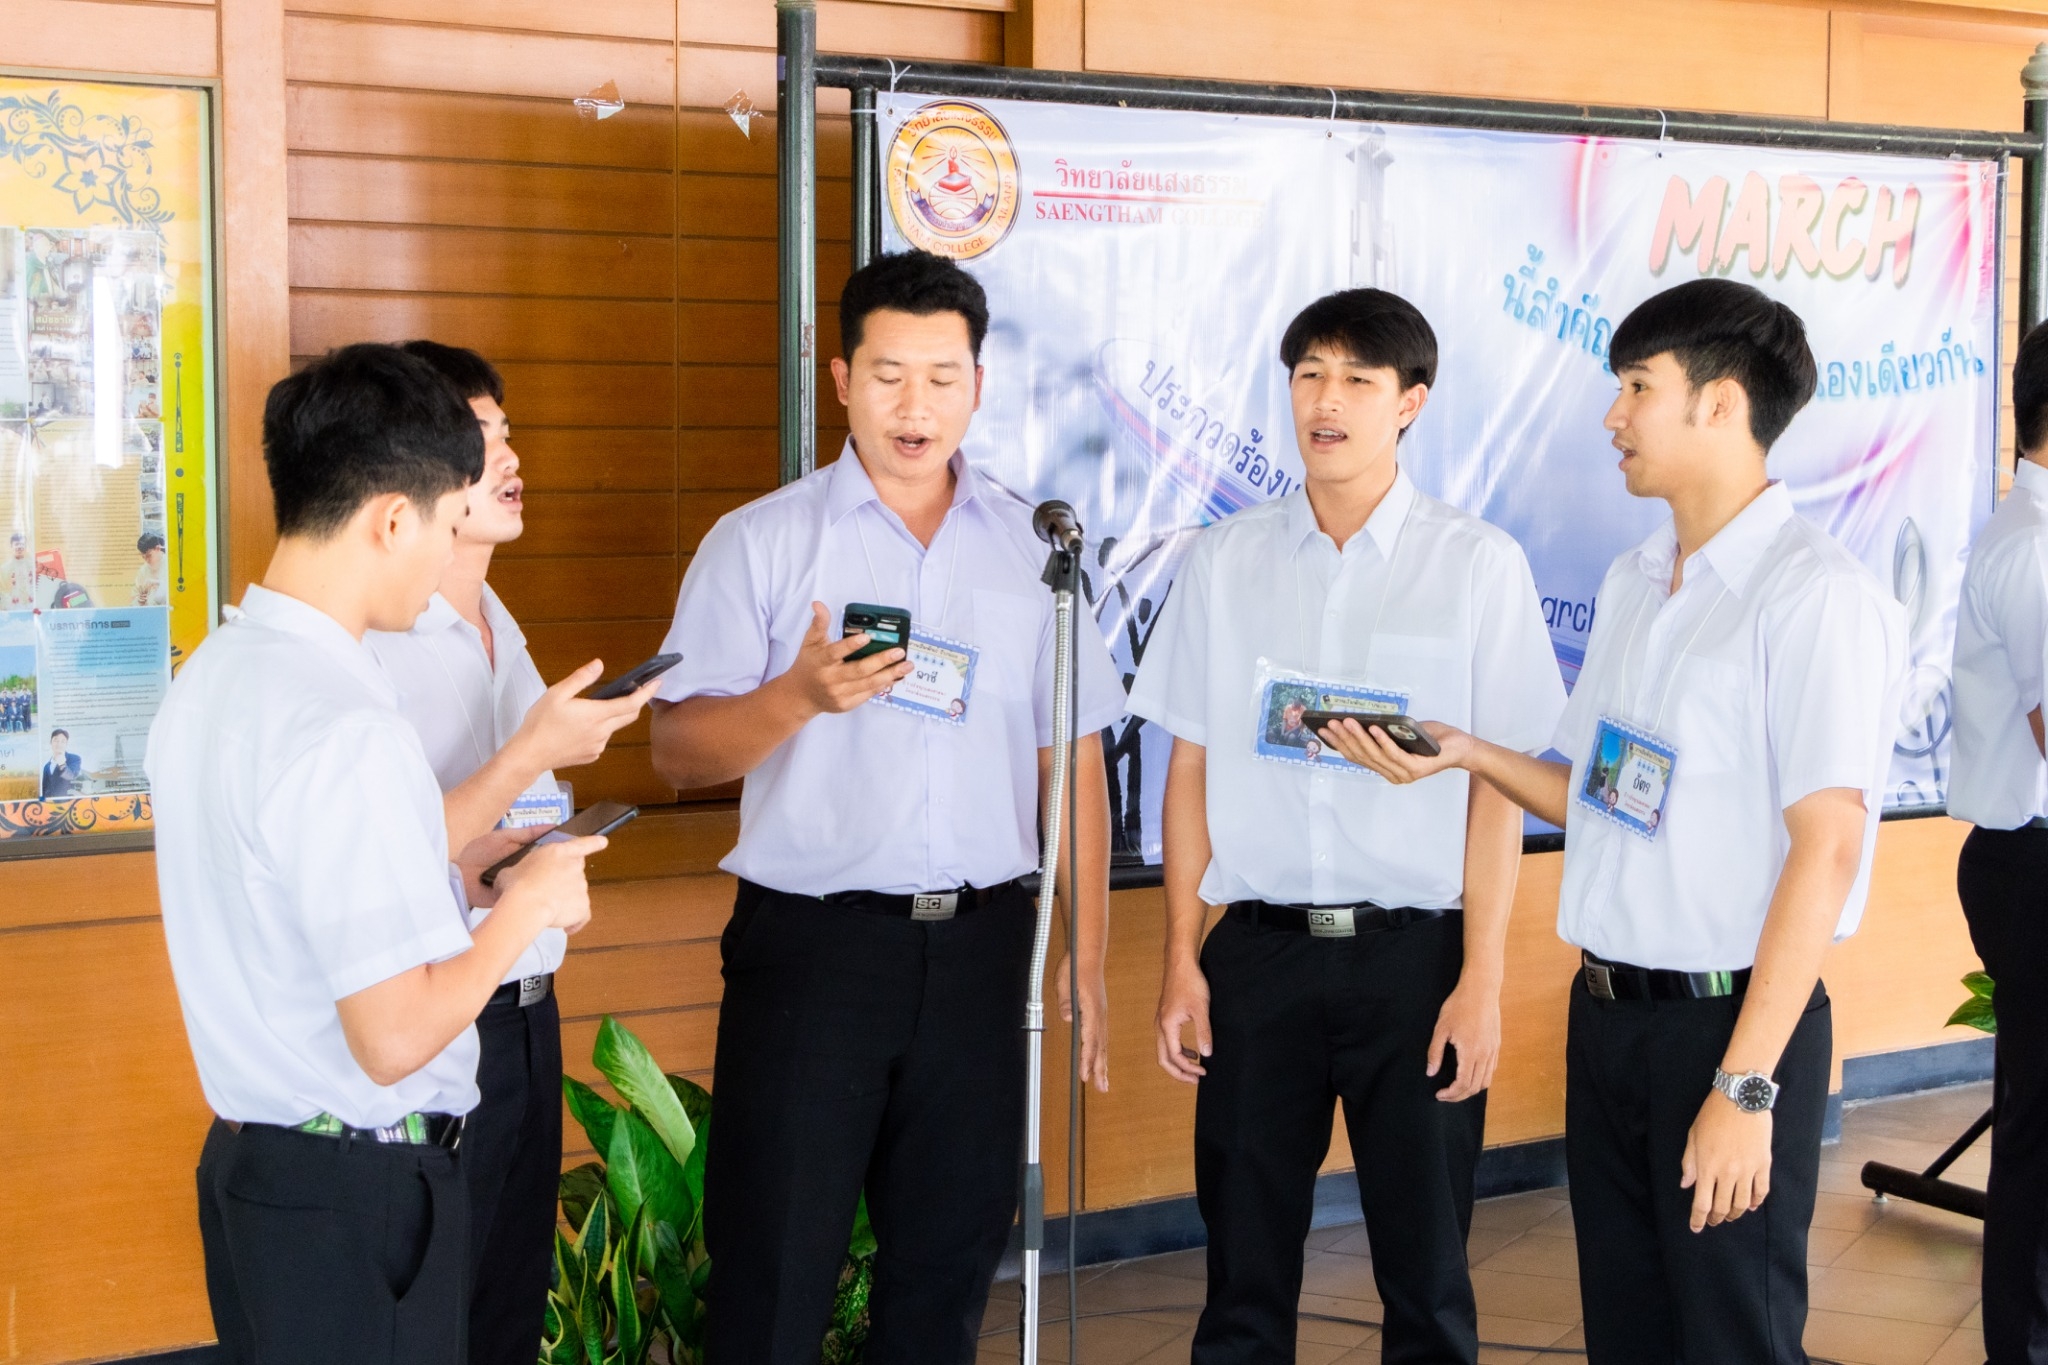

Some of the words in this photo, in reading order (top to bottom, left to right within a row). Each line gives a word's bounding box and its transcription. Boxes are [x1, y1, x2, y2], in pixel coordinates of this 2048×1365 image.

[1055, 158, 1249, 196] วิทยาลัยแสงธรรม
[1035, 201, 1163, 225] SAENGTHAM
[1649, 170, 1922, 289] MARCH
[1138, 359, 1301, 498] ประกวดร้องเ
[1540, 596, 1596, 633] arch
[917, 898, 940, 909] SC
[1311, 913, 1334, 925] SC
[523, 975, 541, 992] SC
